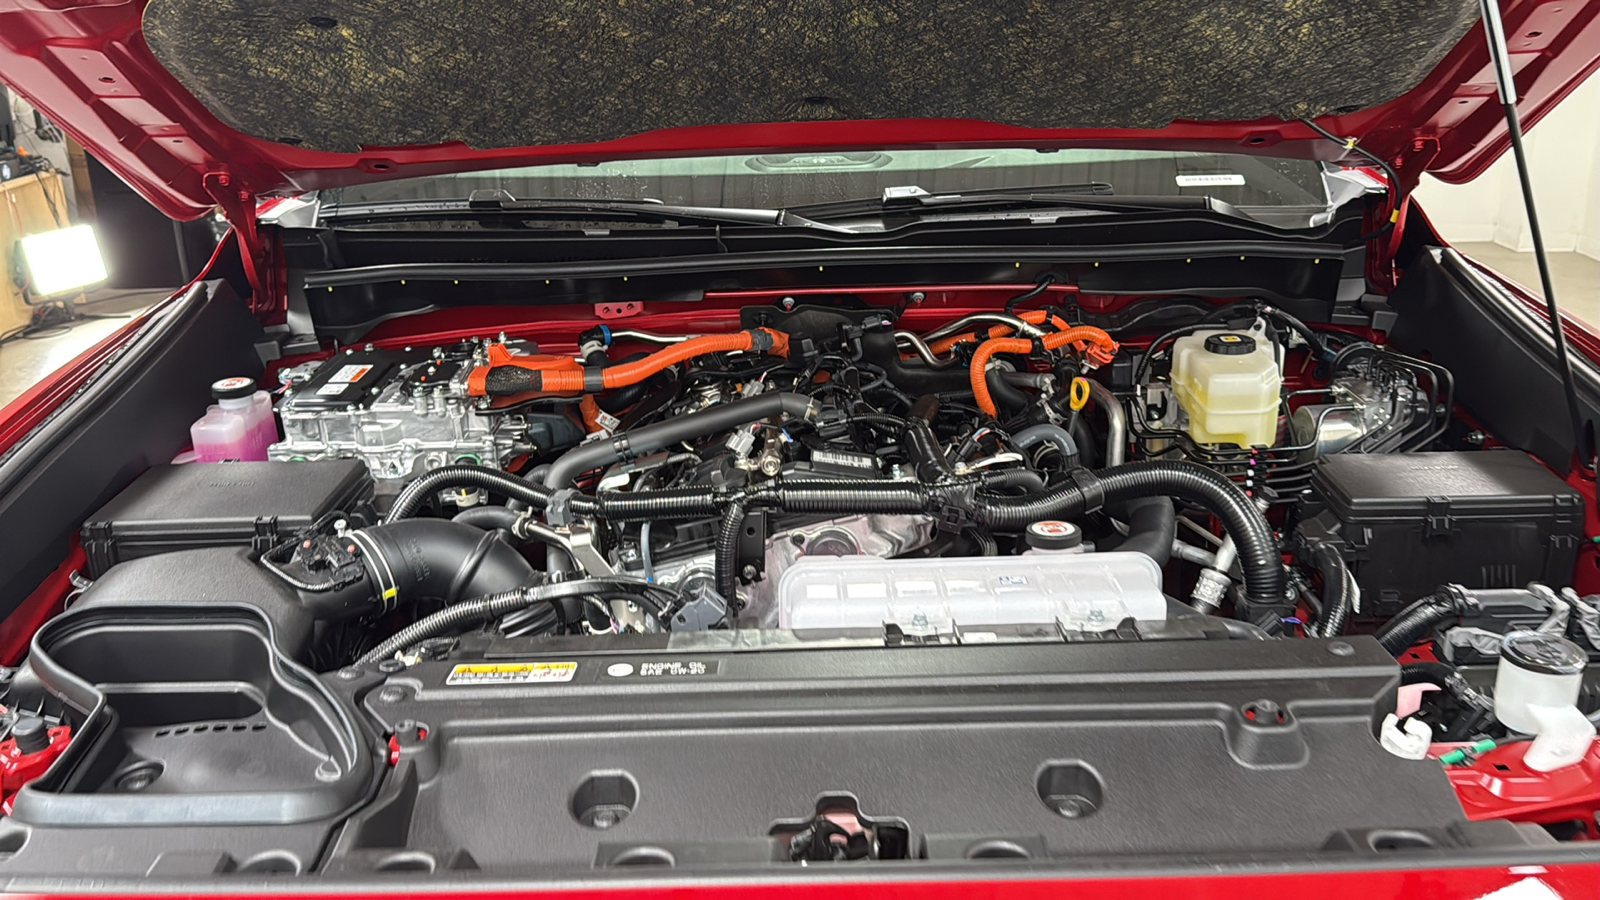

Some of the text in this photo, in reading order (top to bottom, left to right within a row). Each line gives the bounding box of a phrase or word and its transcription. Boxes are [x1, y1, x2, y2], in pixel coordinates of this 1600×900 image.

[641, 661, 706, 670] ENGINE OIL
[640, 668, 663, 676] SAE
